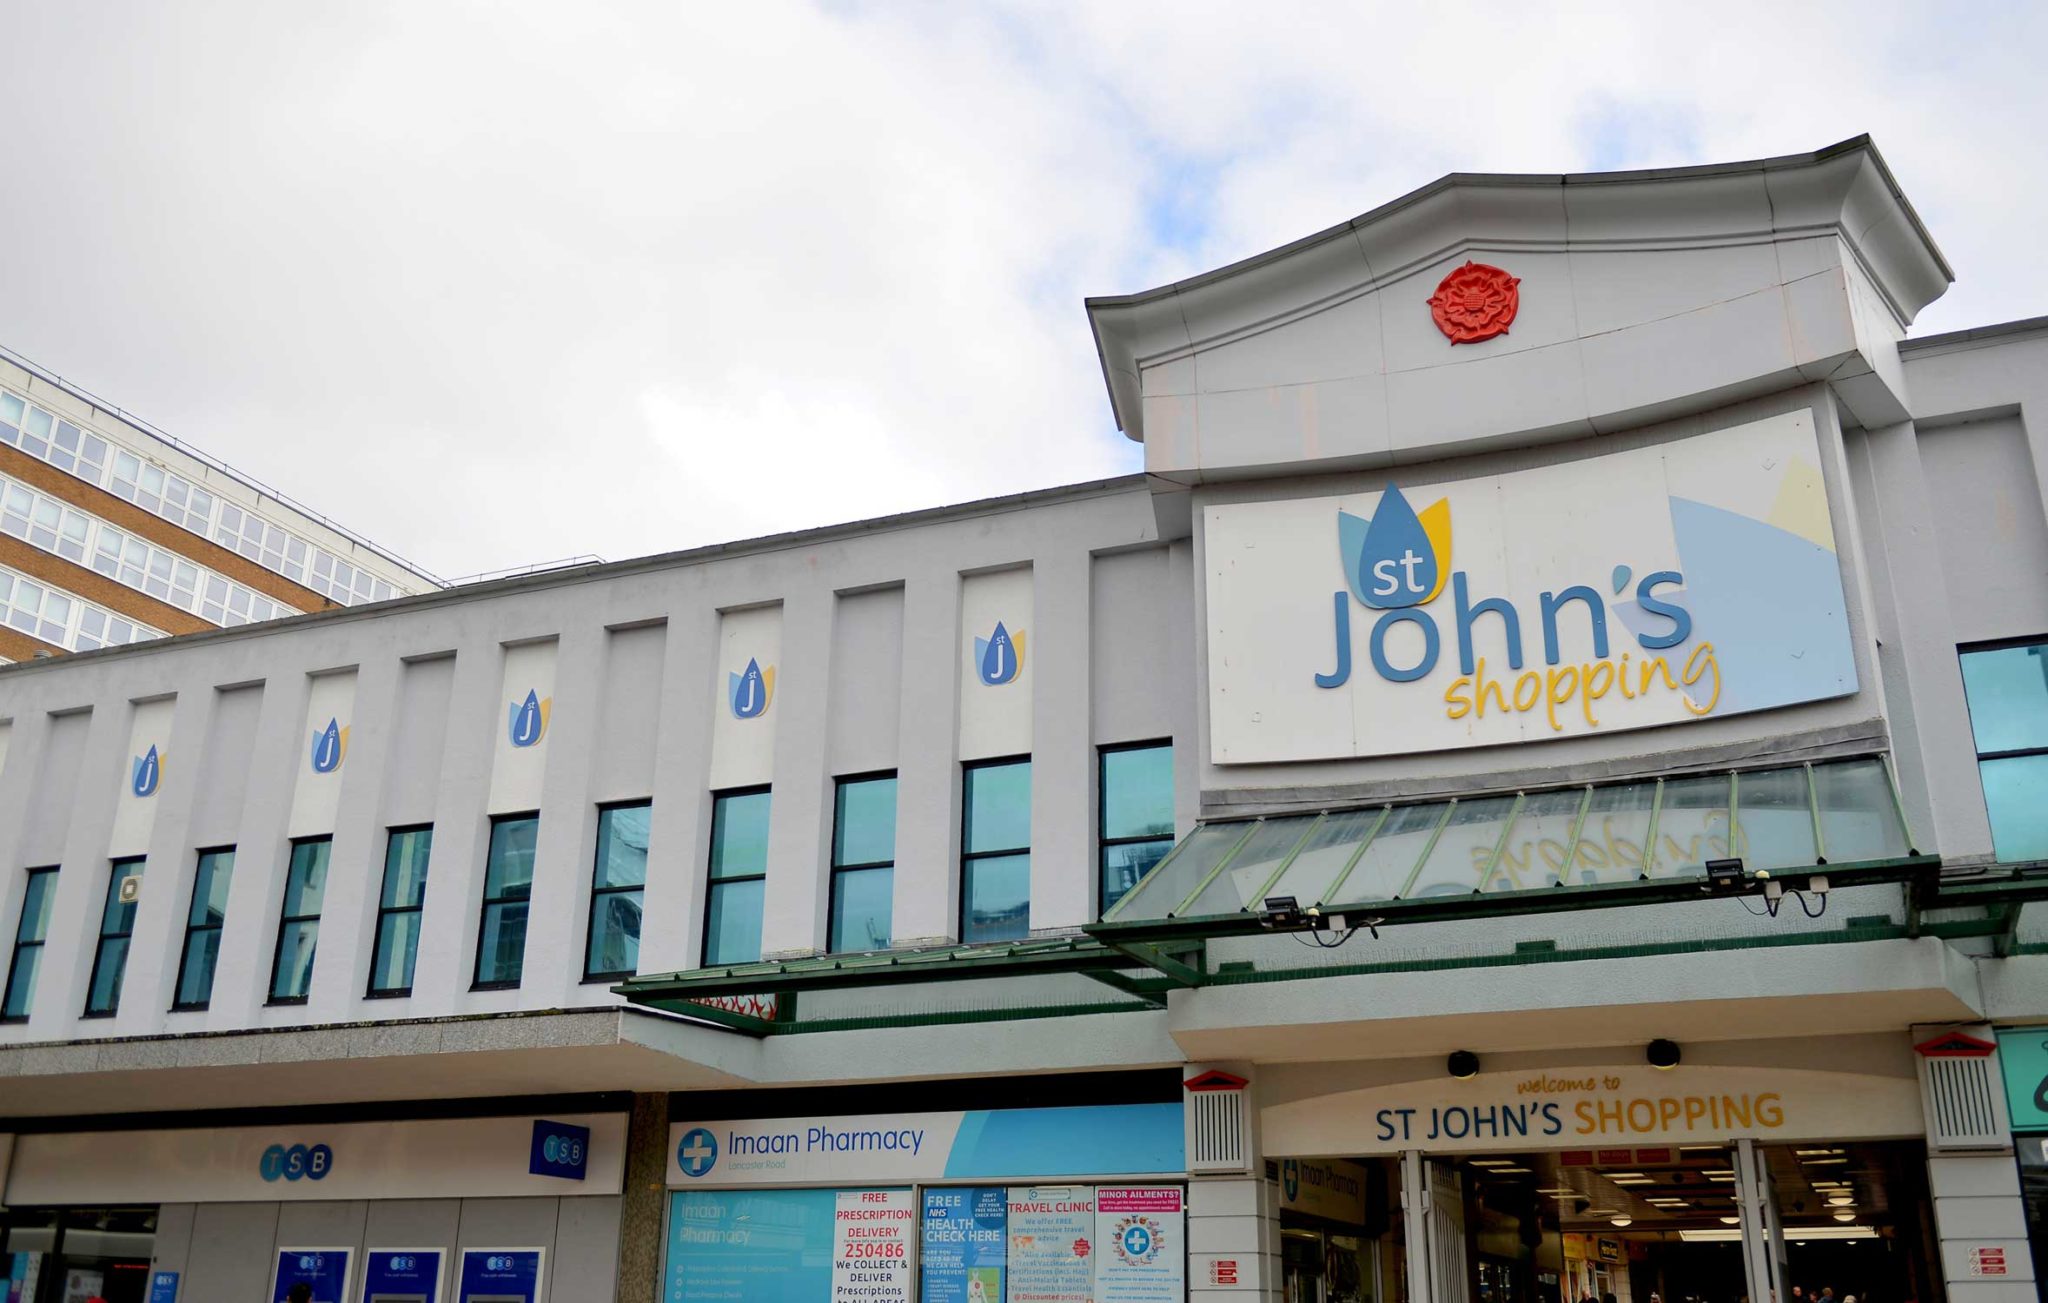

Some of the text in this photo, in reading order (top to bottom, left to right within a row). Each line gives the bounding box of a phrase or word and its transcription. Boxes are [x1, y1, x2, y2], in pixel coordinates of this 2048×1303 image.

[1374, 550, 1424, 596] st
[1444, 642, 1720, 730] shopping
[1517, 1074, 1621, 1095] welcome to
[1376, 1092, 1784, 1142] ST JOHN'S SHOPPING
[729, 1126, 924, 1156] Imaan Pharmacy
[547, 1139, 582, 1161] TSB
[264, 1149, 328, 1175] TSB
[728, 1159, 786, 1170] Lancaster Road
[862, 1193, 888, 1202] FREE
[927, 1195, 962, 1208] FREE
[928, 1208, 947, 1217] NHS
[1008, 1202, 1092, 1213] TRAVEL CLINIC
[837, 1210, 912, 1220] PRESCRIPTION
[927, 1218, 974, 1230] HEALTH
[848, 1228, 899, 1238] DELIVERY
[926, 1230, 1000, 1242] CHECK HERE
[846, 1243, 904, 1258] 250486
[836, 1260, 907, 1269] We COLLECT &
[850, 1273, 892, 1282] DELIVER
[837, 1286, 902, 1296] Prescriptions
